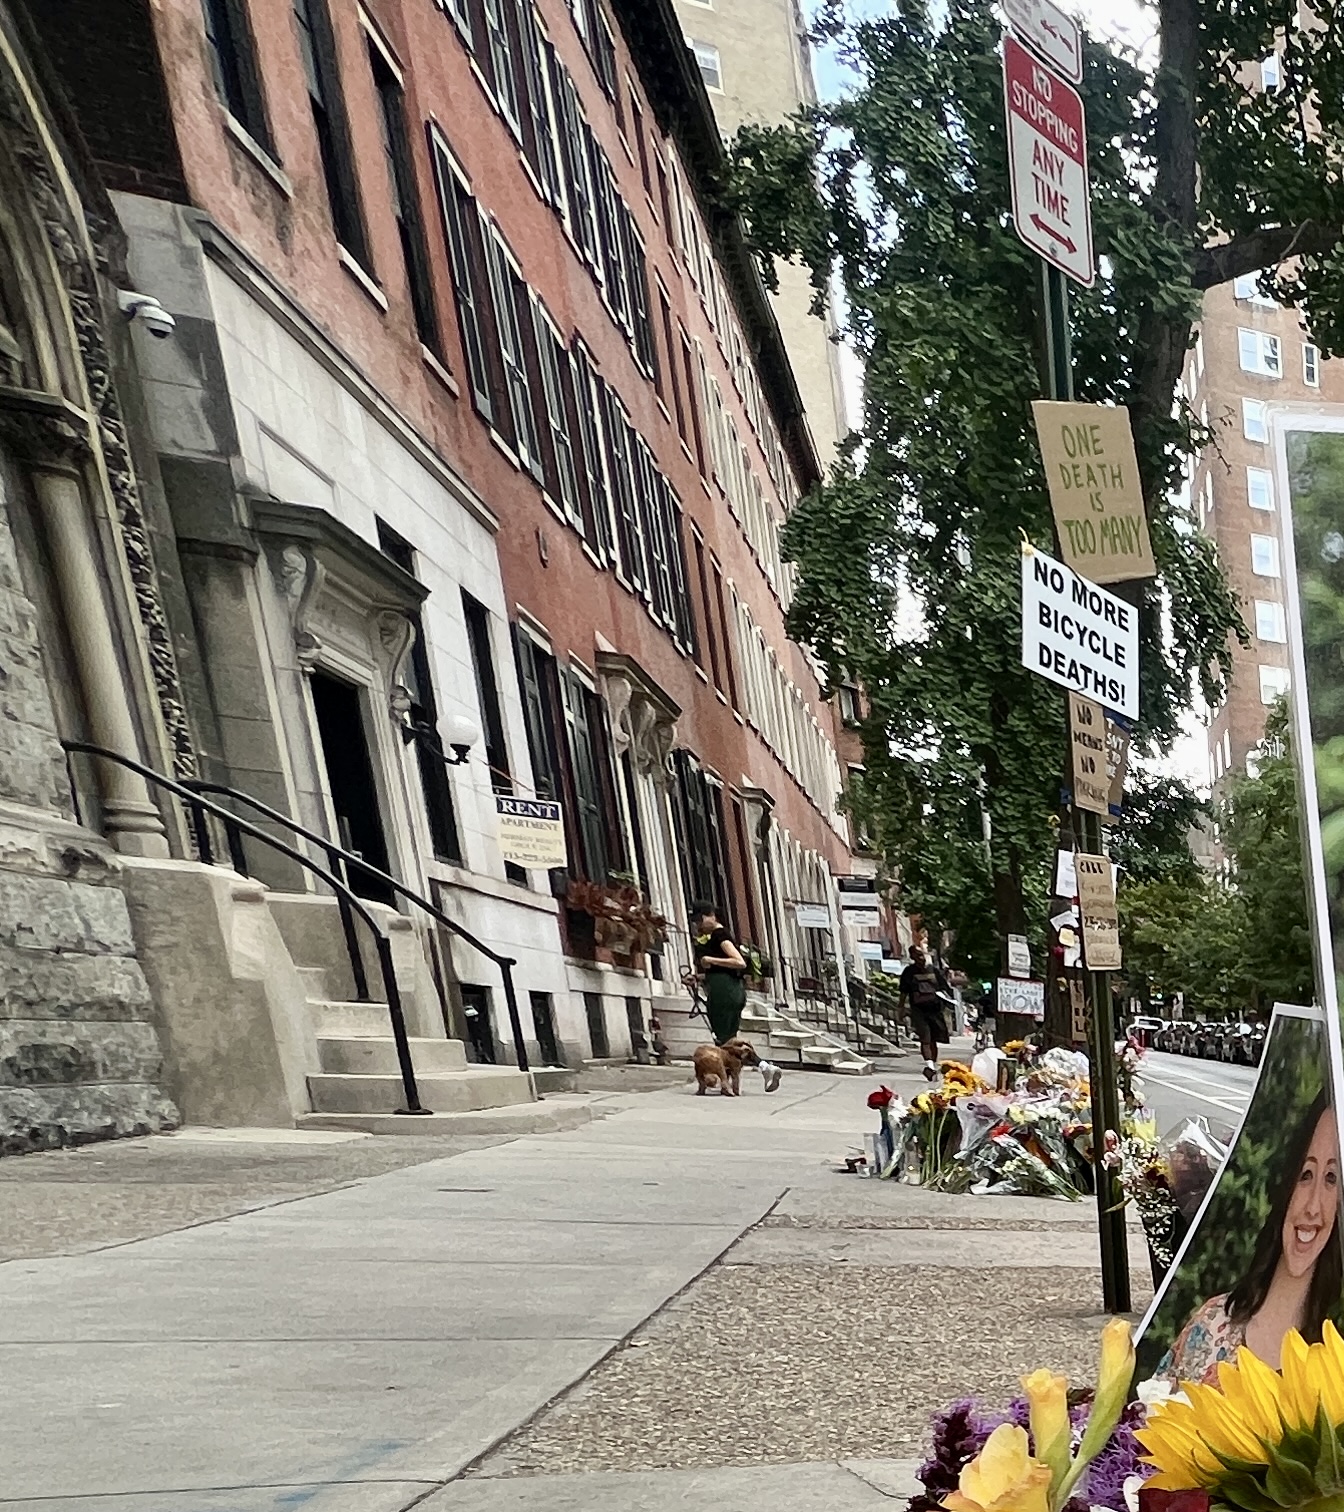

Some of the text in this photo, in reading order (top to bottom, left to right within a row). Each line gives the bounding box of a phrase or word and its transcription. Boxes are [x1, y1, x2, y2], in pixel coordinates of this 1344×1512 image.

[1031, 63, 1053, 102] NO
[1012, 80, 1078, 153] STOPPING
[1032, 139, 1065, 188] ANY
[1031, 172, 1071, 227] TIME
[1061, 424, 1104, 458] ONE
[1058, 463, 1124, 490] DEATH
[1090, 491, 1104, 512] IS
[1062, 515, 1143, 558] TOO MANY
[1034, 557, 1130, 633] NO MORE
[1038, 600, 1126, 669] BICYCLE
[1038, 642, 1126, 706] DEATHS!
[1077, 704, 1093, 726] NO
[1081, 755, 1096, 775] NO
[500, 799, 555, 818] RENT
[501, 817, 558, 831] APARTMENT
